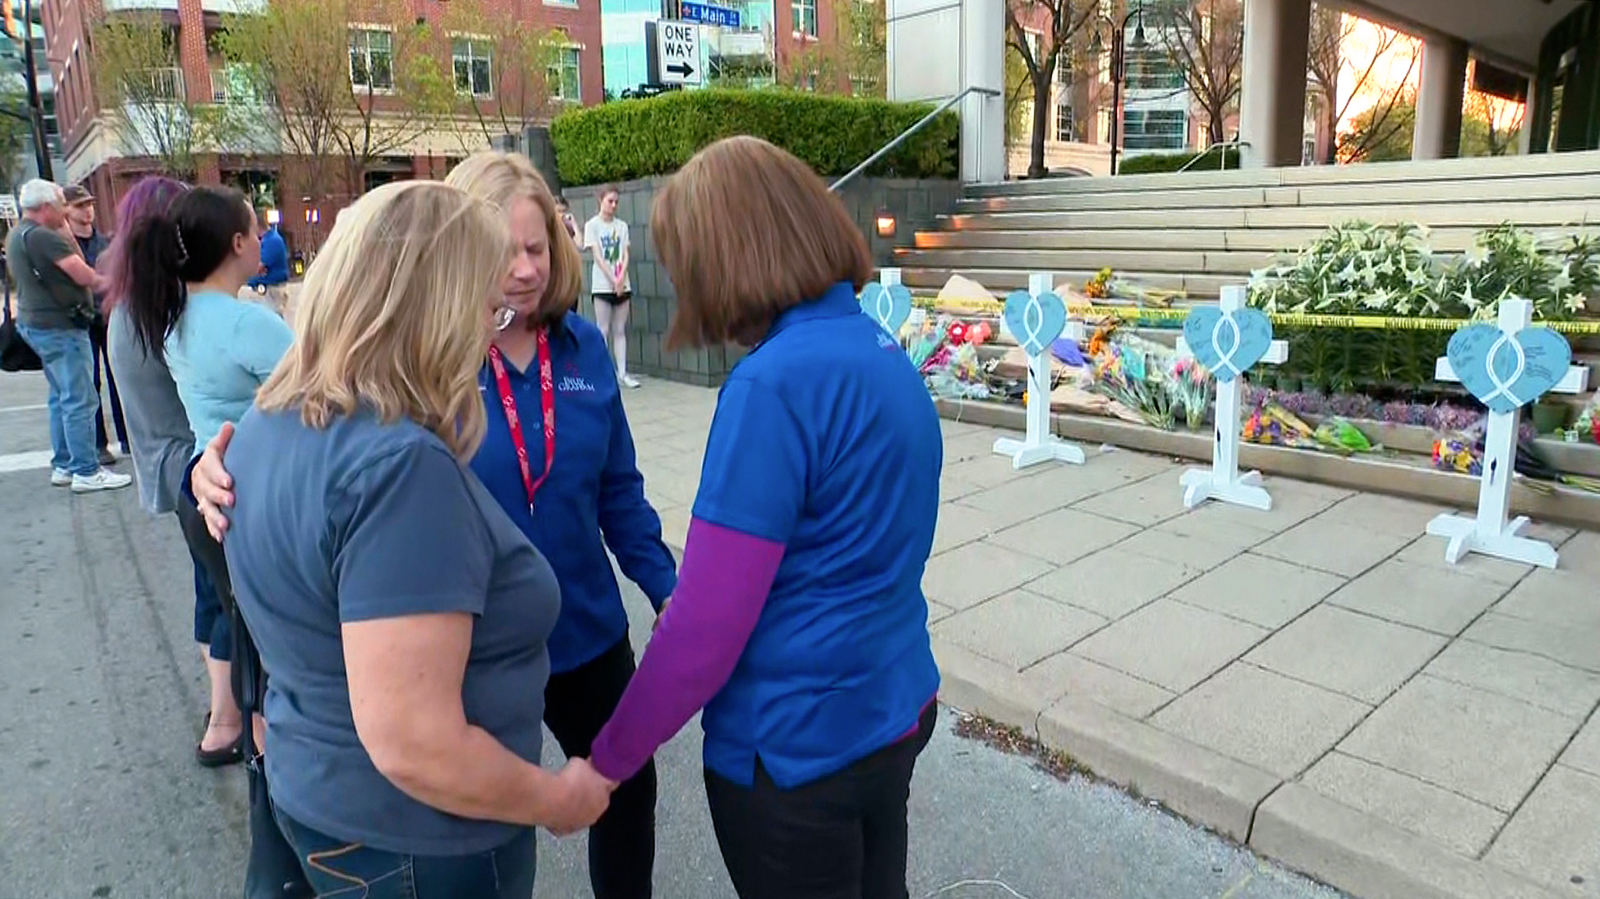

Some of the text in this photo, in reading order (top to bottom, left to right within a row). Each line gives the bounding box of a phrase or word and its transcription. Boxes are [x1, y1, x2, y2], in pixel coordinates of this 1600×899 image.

[692, 7, 698, 18] E
[701, 7, 726, 24] Main
[665, 25, 693, 42] ONE
[665, 42, 694, 58] WAY
